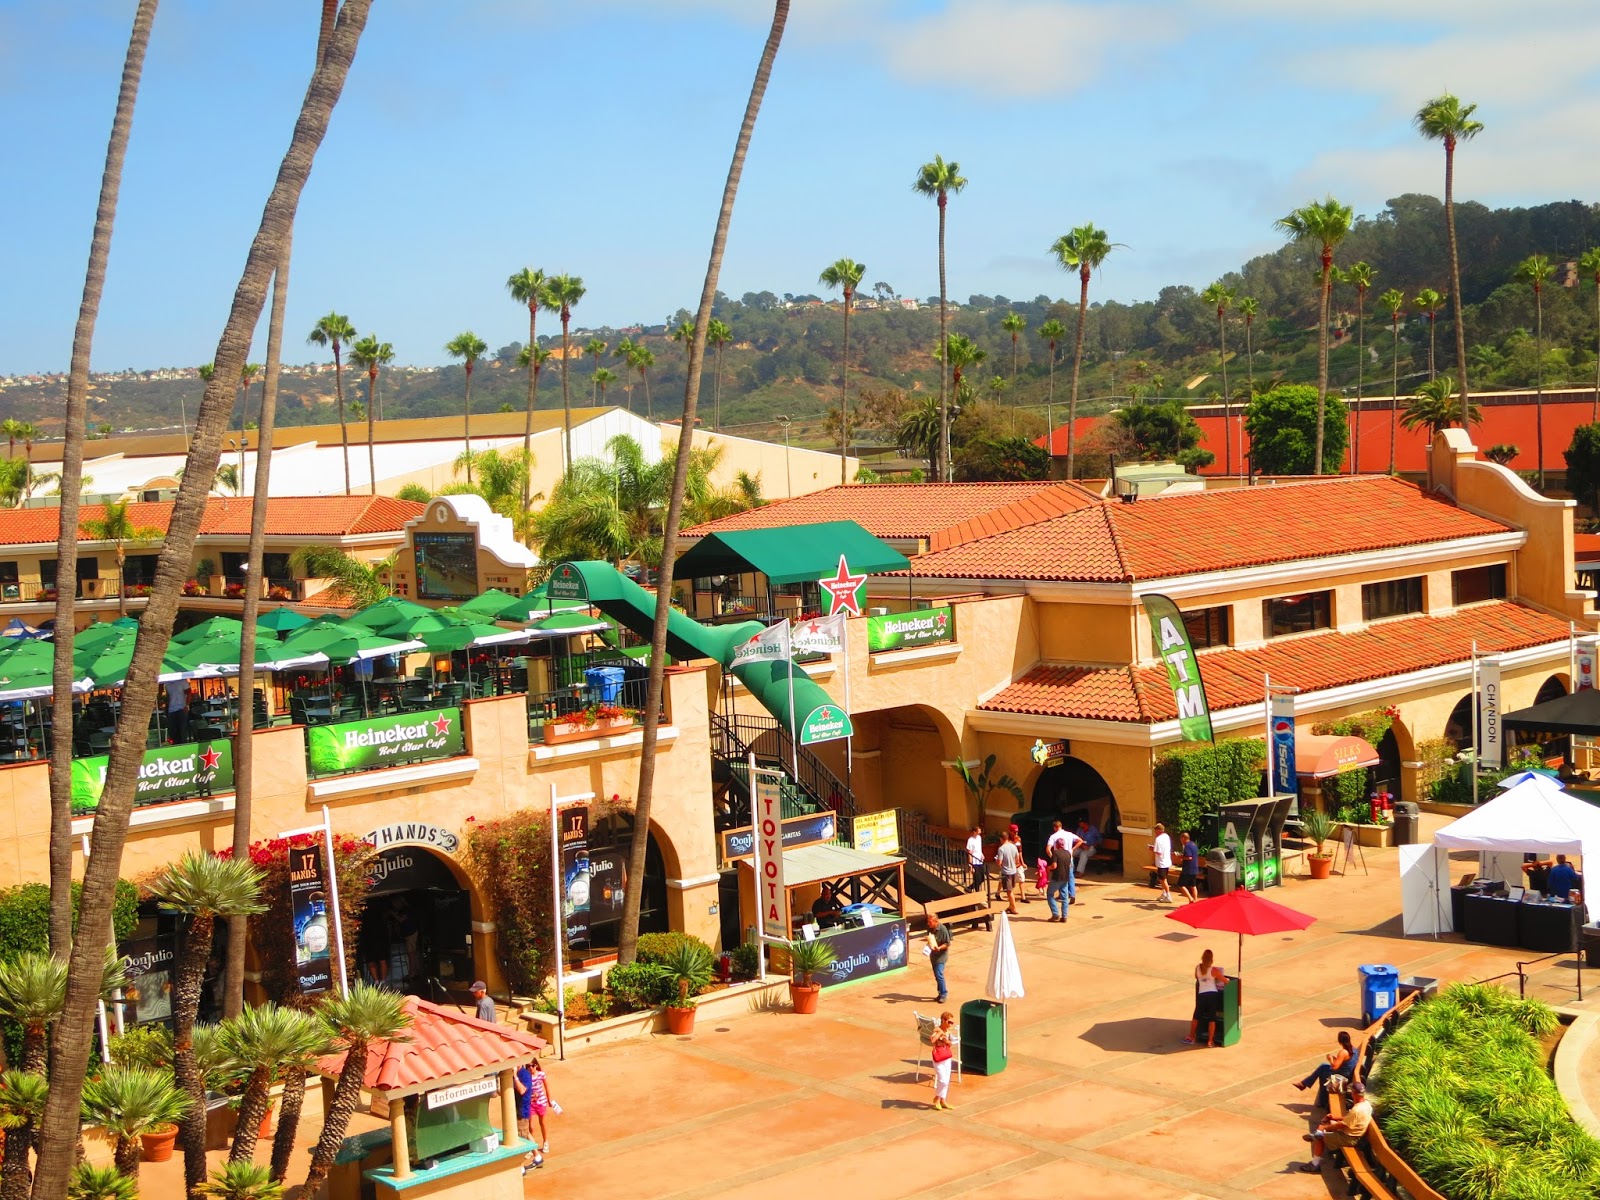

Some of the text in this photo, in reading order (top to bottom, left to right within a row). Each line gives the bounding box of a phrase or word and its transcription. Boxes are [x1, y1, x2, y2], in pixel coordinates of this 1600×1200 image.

[884, 617, 934, 635] Heineken
[1160, 616, 1205, 720] ATM
[1487, 683, 1497, 744] CHANDON
[344, 723, 428, 749] Heineken
[809, 720, 843, 734] Heineken
[378, 744, 399, 756] Red
[401, 741, 424, 752] Star
[1047, 743, 1064, 753] SILKS
[1334, 743, 1361, 760] SILKS
[1279, 743, 1289, 788] PEPSI
[138, 779, 161, 792] Red
[164, 775, 189, 788] Star
[571, 816, 583, 831] 17
[382, 823, 438, 844] HANDS
[563, 829, 584, 841] HANDS
[301, 853, 315, 871] 17
[763, 798, 779, 922] TOYOTA
[291, 868, 318, 881] HANDS
[432, 1081, 494, 1103] Information
